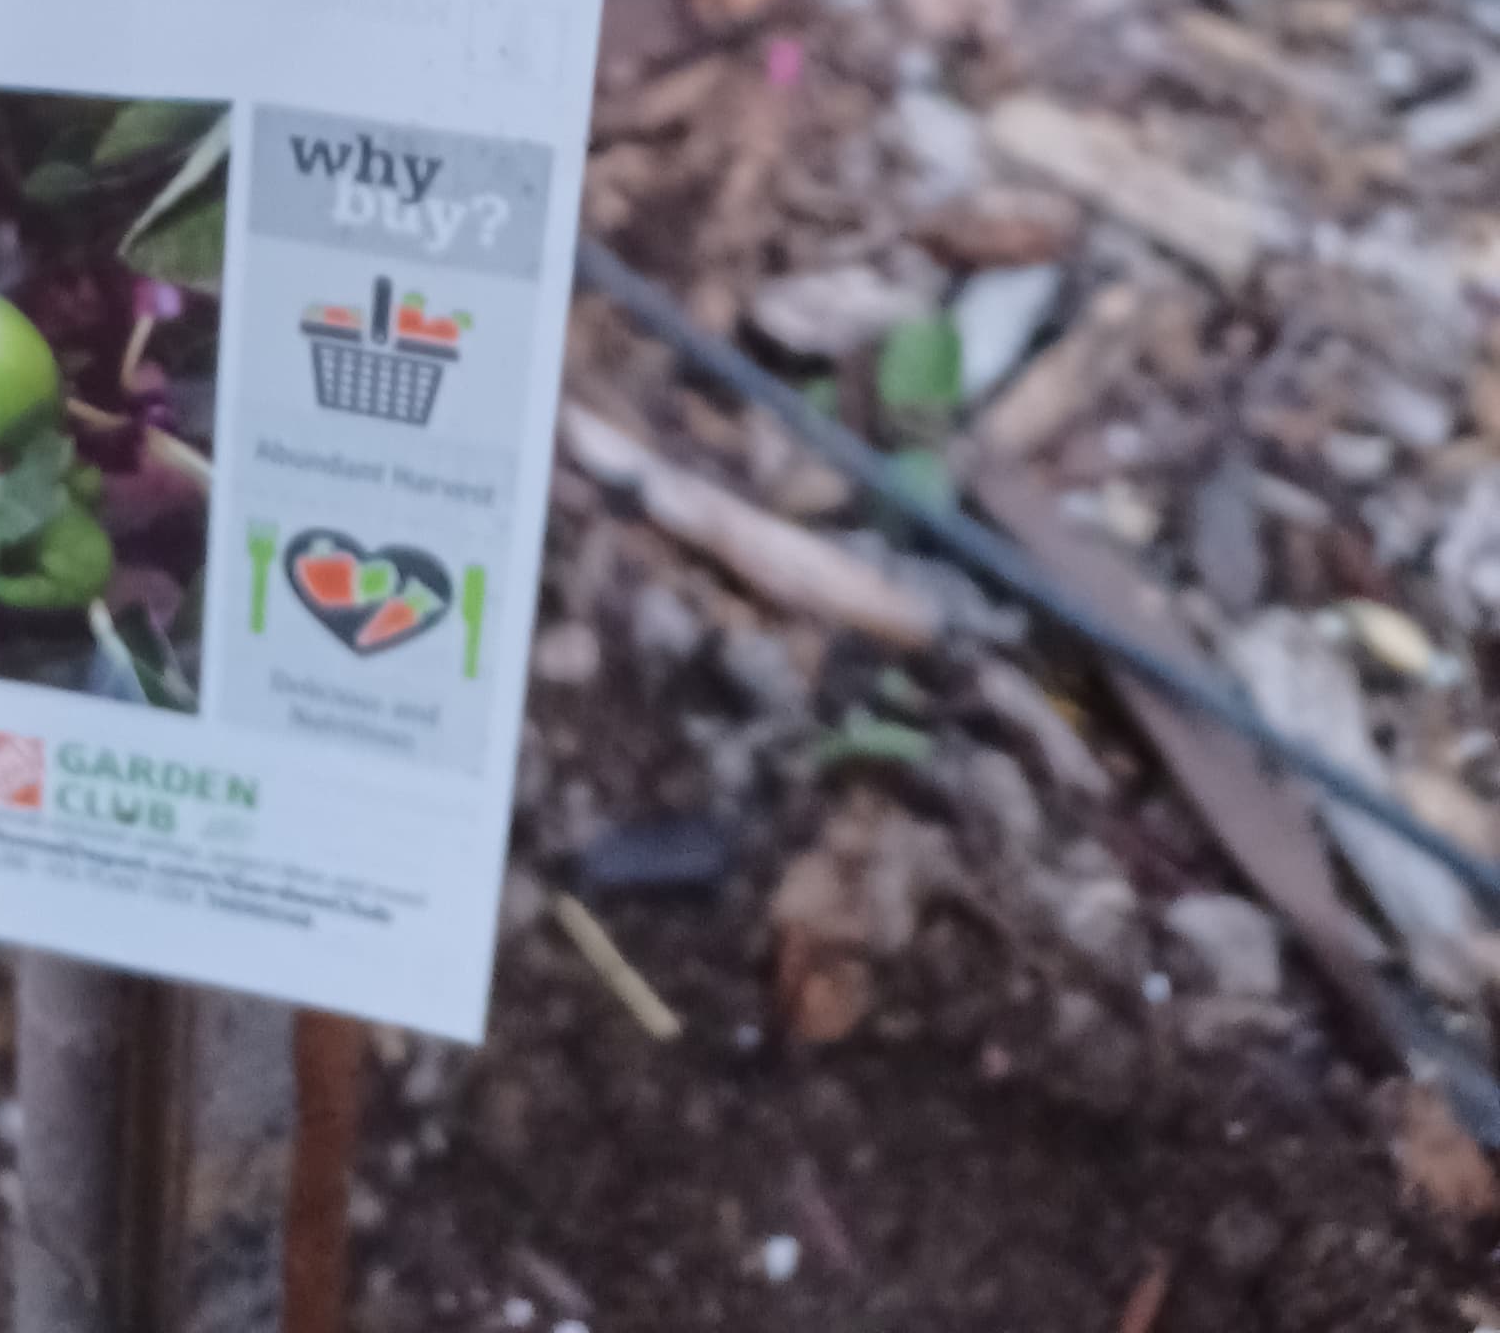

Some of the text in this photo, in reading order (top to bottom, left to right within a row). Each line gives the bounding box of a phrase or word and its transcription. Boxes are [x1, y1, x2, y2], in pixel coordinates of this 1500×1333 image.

[289, 132, 444, 204] why
[332, 177, 511, 253] buy?
[55, 783, 178, 835] CLUB
[56, 740, 261, 811] GARDEN
